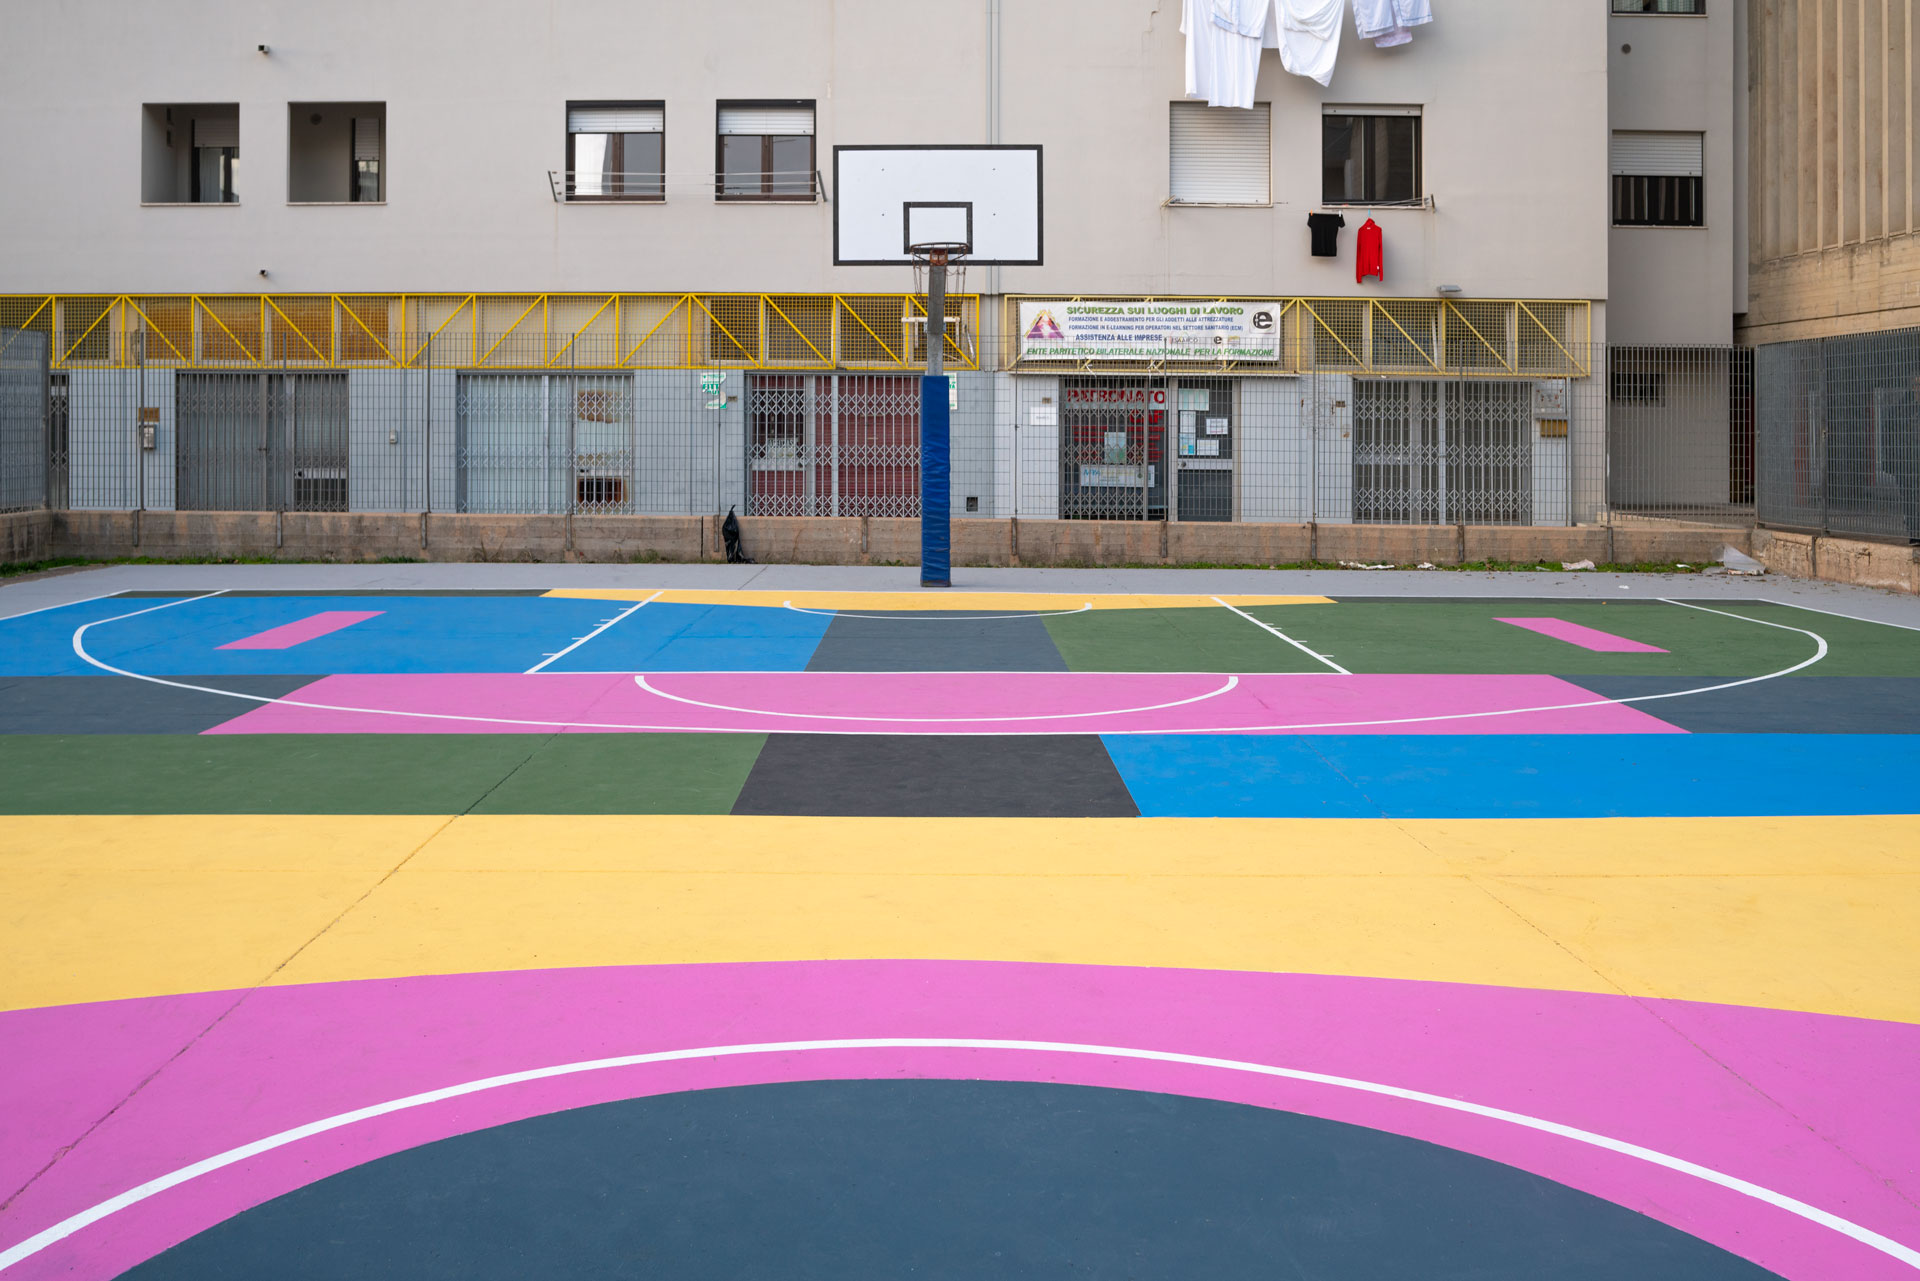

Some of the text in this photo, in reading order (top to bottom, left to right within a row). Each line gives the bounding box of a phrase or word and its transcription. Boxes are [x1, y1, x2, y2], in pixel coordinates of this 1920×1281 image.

[1067, 307, 1244, 315] SICUREZZA SUI LUOGHI DI LAVORO
[1145, 348, 1191, 356] NAZIONALE
[1194, 348, 1210, 356] PER
[1211, 348, 1221, 356] LA
[1224, 348, 1275, 356] FORMAZIONE
[1067, 390, 1165, 403] PATRONATO
